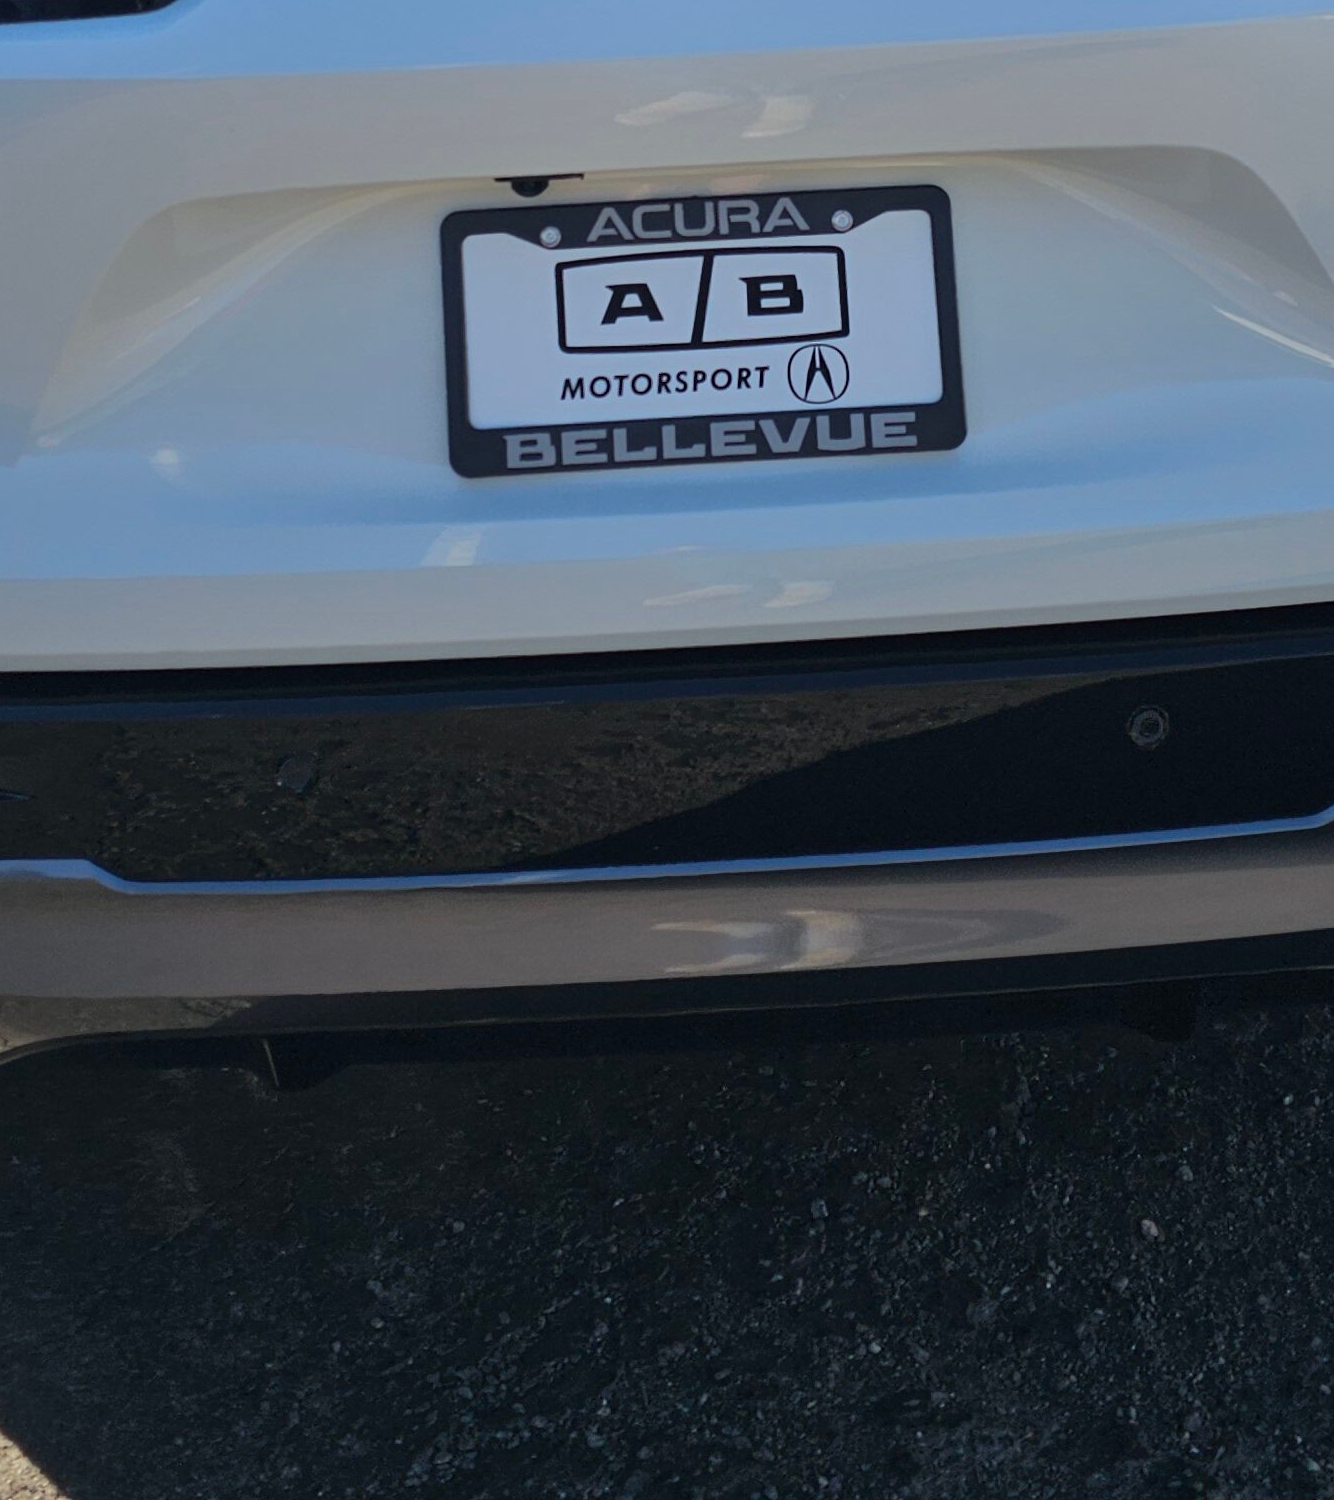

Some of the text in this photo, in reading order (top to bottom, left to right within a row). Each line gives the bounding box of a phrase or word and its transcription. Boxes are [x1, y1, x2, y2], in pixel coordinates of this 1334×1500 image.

[586, 197, 811, 242] ACURA
[601, 274, 804, 325] A B
[561, 365, 770, 400] MOTORSPORT
[503, 411, 917, 469] BELLEVUE
